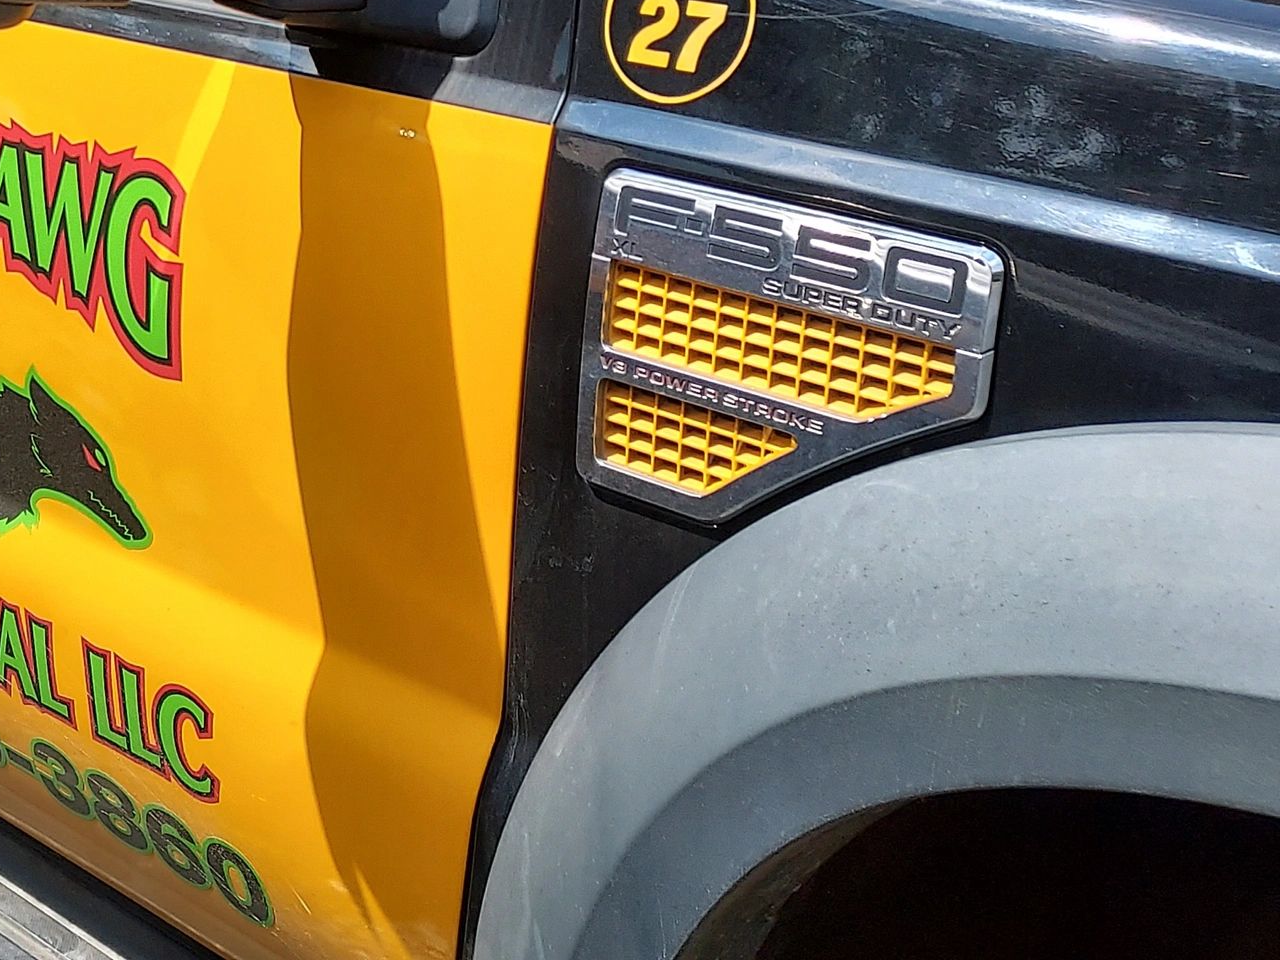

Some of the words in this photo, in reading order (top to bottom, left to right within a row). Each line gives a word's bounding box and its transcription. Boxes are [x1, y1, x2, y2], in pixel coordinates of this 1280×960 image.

[610, 238, 644, 261] XL
[762, 277, 864, 320] SUPER
[870, 302, 962, 340] DUTY
[632, 367, 720, 404] POWER
[722, 394, 825, 436] STROKE
[81, 638, 221, 804] LLC
